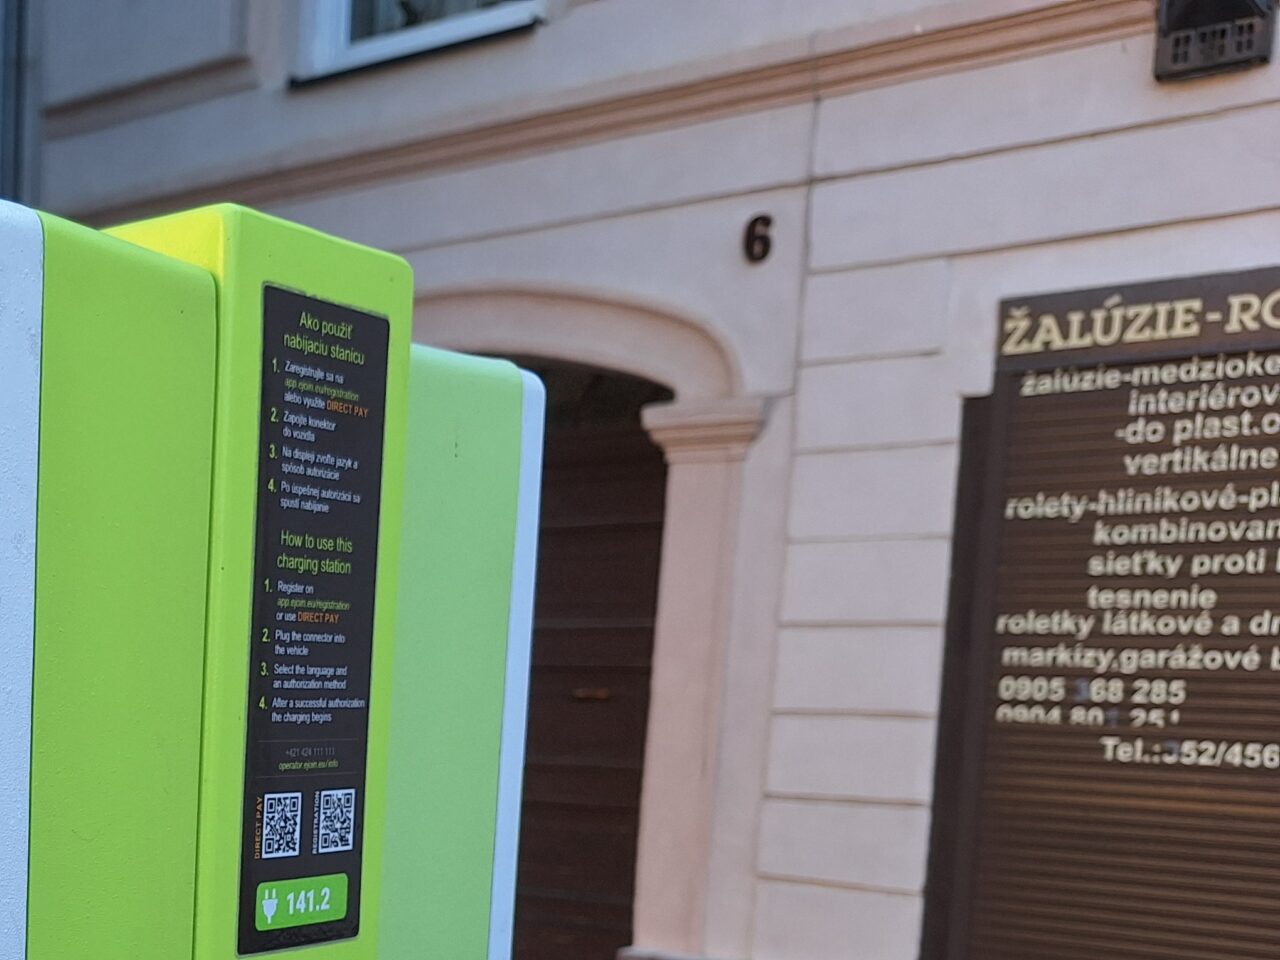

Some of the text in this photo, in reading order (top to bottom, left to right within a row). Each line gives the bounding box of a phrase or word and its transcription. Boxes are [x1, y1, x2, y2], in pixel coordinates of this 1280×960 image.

[744, 213, 772, 263] 6
[299, 310, 353, 340] Ako použiť
[330, 345, 365, 365] stanicu
[272, 357, 280, 373] 1.
[325, 372, 334, 382] sa
[270, 407, 279, 422] 2.
[283, 391, 302, 405] alebo
[326, 400, 353, 415] DIRECT
[354, 406, 369, 418] PAY
[282, 426, 291, 437] do
[269, 444, 278, 459] 3.
[282, 446, 292, 458] Na
[1123, 443, 1280, 476] vertikálne
[267, 478, 277, 492] 4.
[281, 480, 290, 493] Po
[281, 530, 353, 553] How to use this
[277, 552, 351, 576] charging station
[1190, 547, 1266, 578] proti
[264, 578, 314, 595] 1. Register on
[1087, 582, 1218, 610] tesnenie
[276, 612, 339, 624] or use DIRECT PAY
[997, 609, 1096, 641] roletky
[1102, 608, 1214, 636] látkové
[1220, 614, 1241, 637] a
[261, 627, 270, 642] 2.
[275, 629, 291, 644] Plug
[291, 630, 302, 642] the
[302, 632, 334, 643] connector
[274, 645, 309, 656] the vehicle
[261, 662, 348, 678] 3. Select the language and
[273, 679, 347, 690] an authorization method
[998, 676, 1066, 702] 0905
[1130, 678, 1187, 705] 285
[259, 696, 268, 710] 4.
[272, 697, 289, 708] After
[295, 697, 328, 708] successful
[328, 697, 366, 709] authorization
[271, 711, 333, 725] the charging begins
[312, 791, 320, 855] REGISTRATION
[254, 820, 262, 859] DIRECT
[286, 886, 330, 915] 141.2
